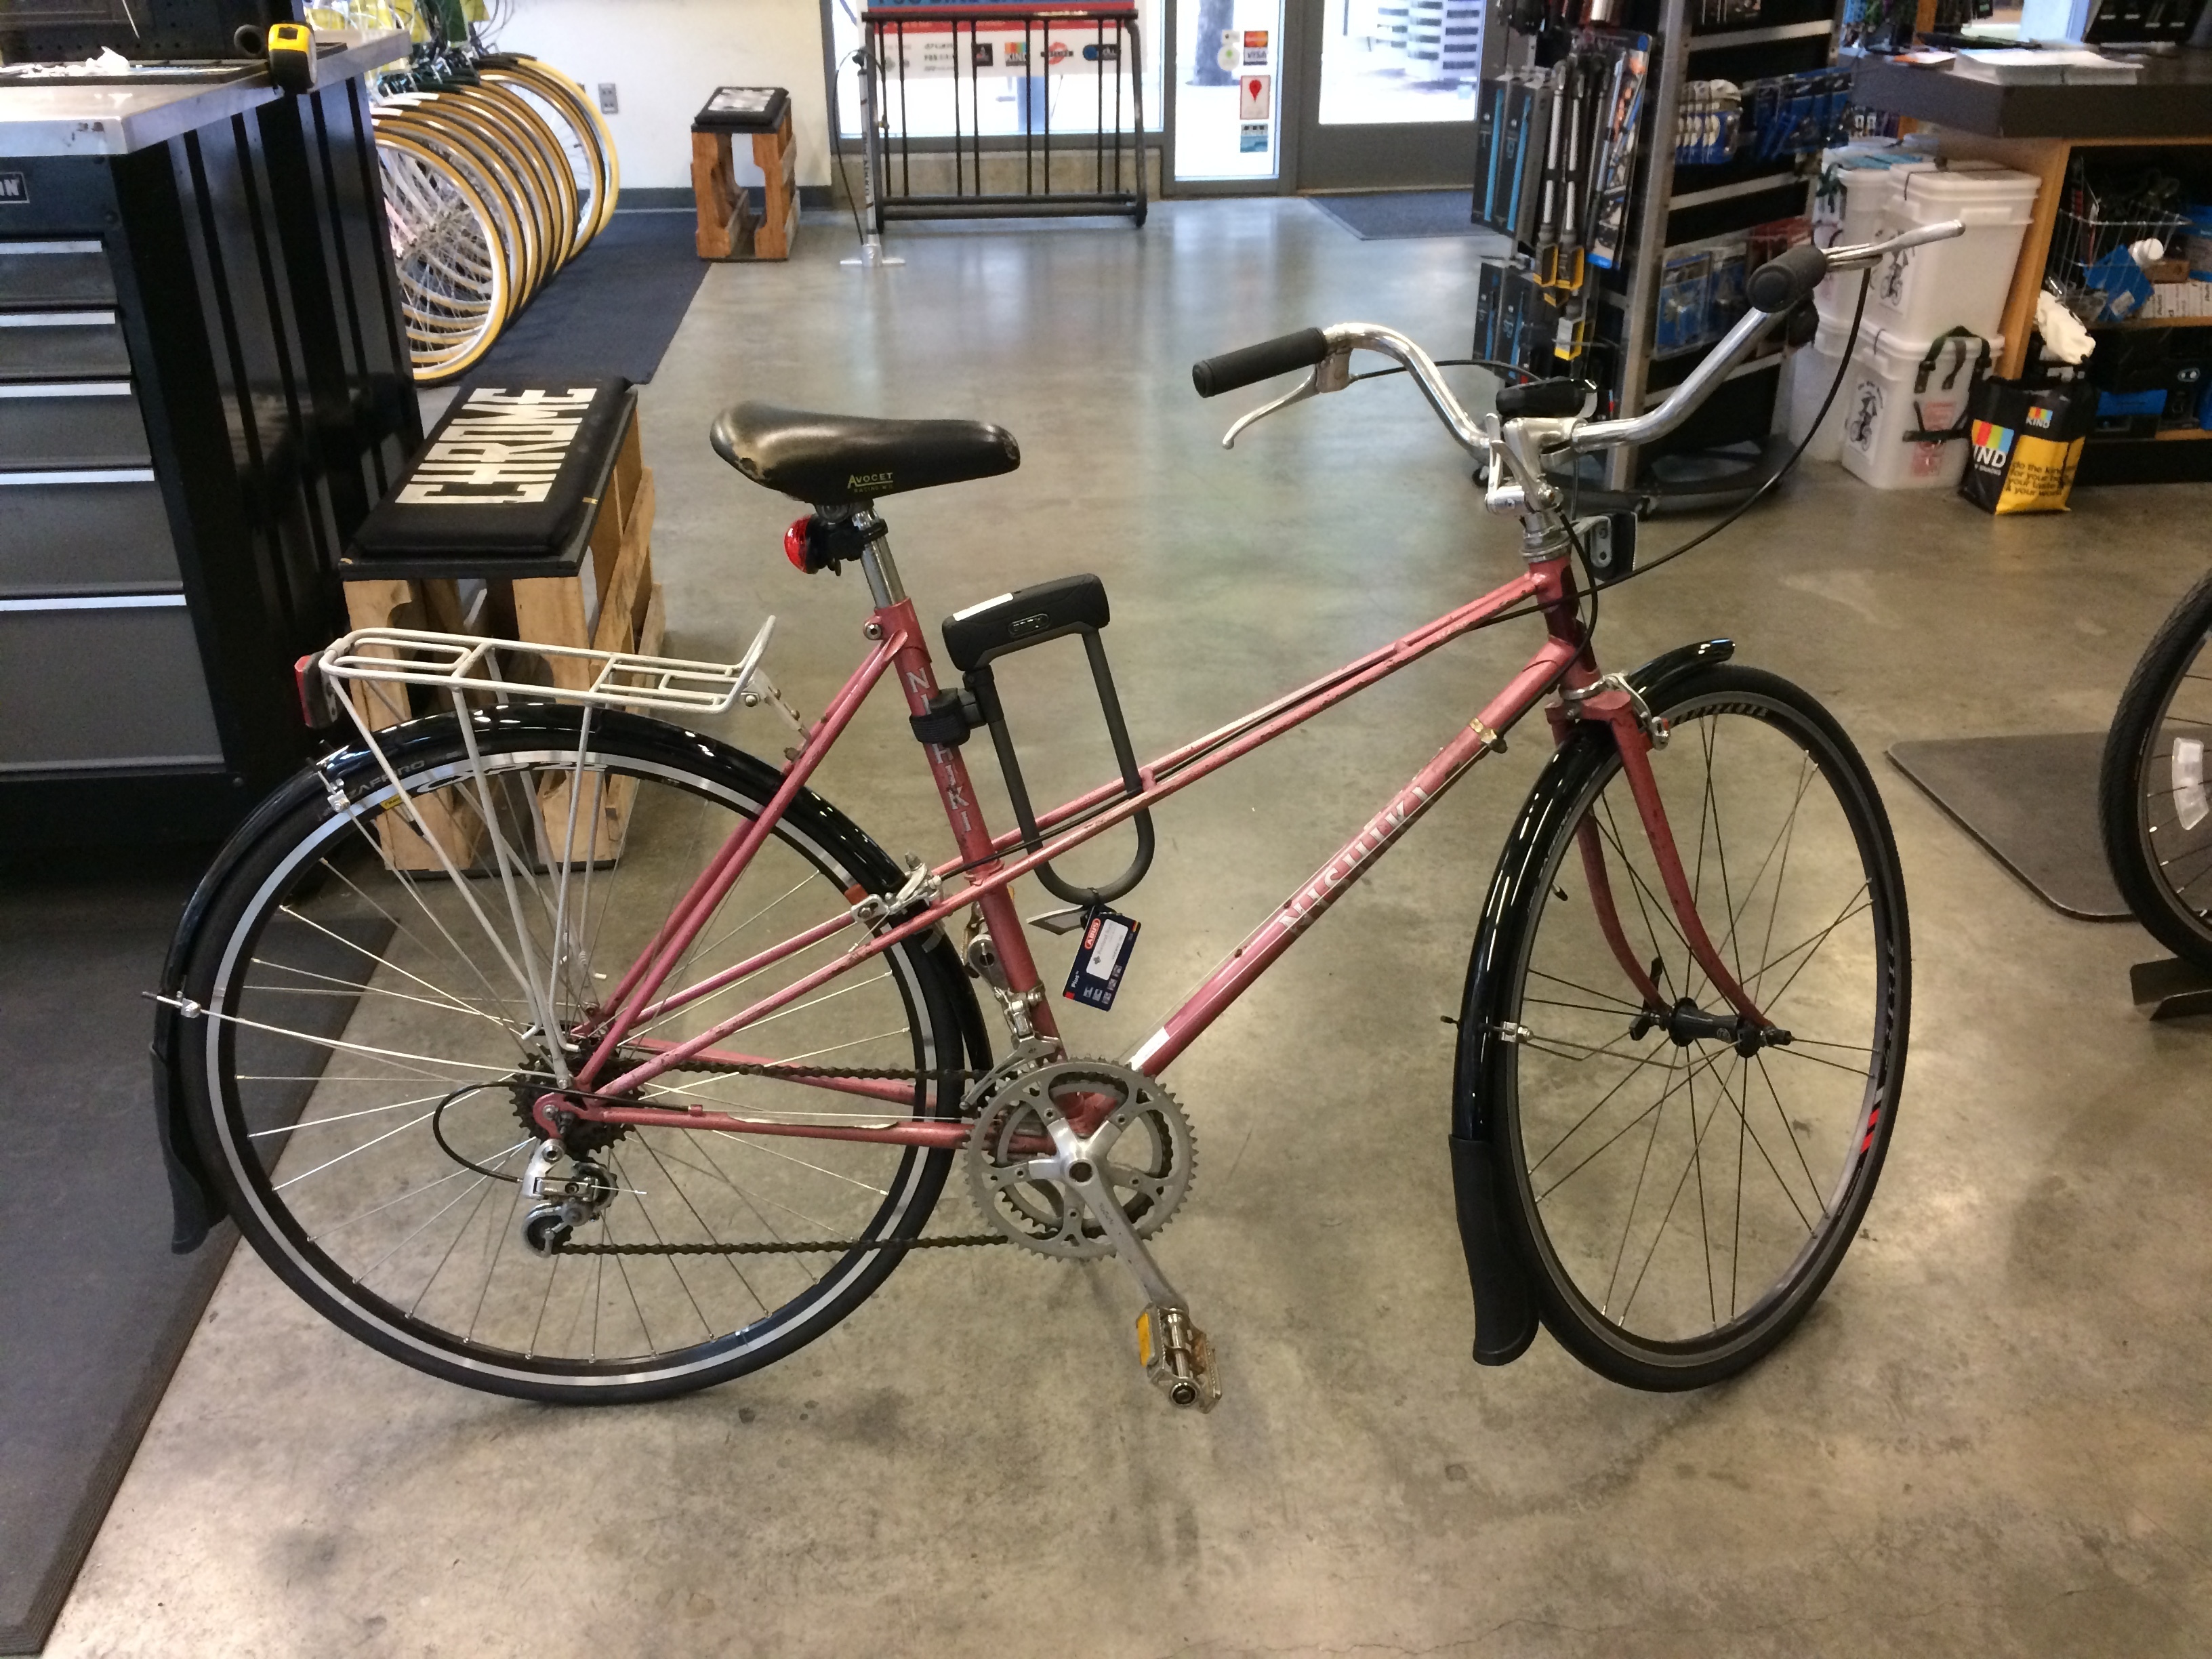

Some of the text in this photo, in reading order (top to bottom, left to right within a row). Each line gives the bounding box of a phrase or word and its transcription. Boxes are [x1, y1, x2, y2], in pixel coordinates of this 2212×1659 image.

[2026, 417, 2051, 428] KIND
[395, 388, 597, 503] CHROME
[1973, 445, 2007, 468] IND
[847, 472, 893, 489] AVOCET
[906, 668, 972, 832] NIHIKI
[1278, 786, 1433, 937] NISHIKI
[1086, 921, 1100, 946] ABUS
